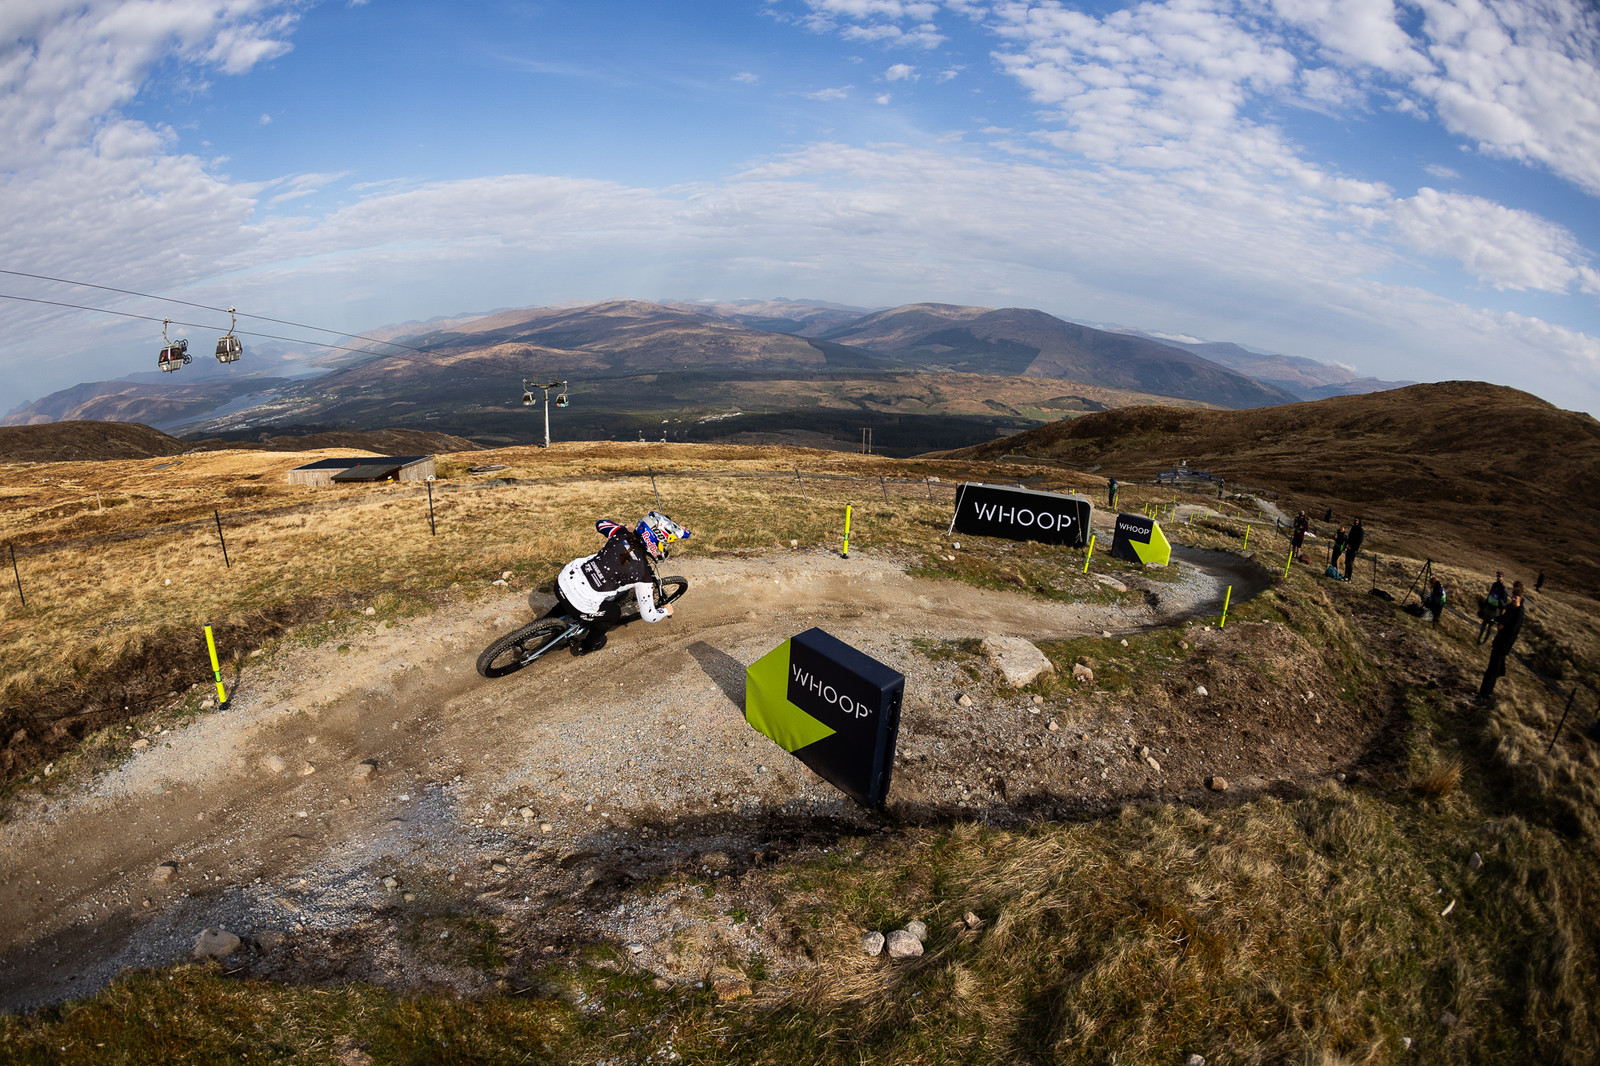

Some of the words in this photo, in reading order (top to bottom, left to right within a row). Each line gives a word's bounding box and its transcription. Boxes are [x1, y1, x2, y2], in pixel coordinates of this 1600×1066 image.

[974, 501, 1072, 532] WHOOP
[1118, 522, 1151, 535] WHOOP
[641, 531, 656, 548] Red
[792, 663, 869, 719] WHOOP
